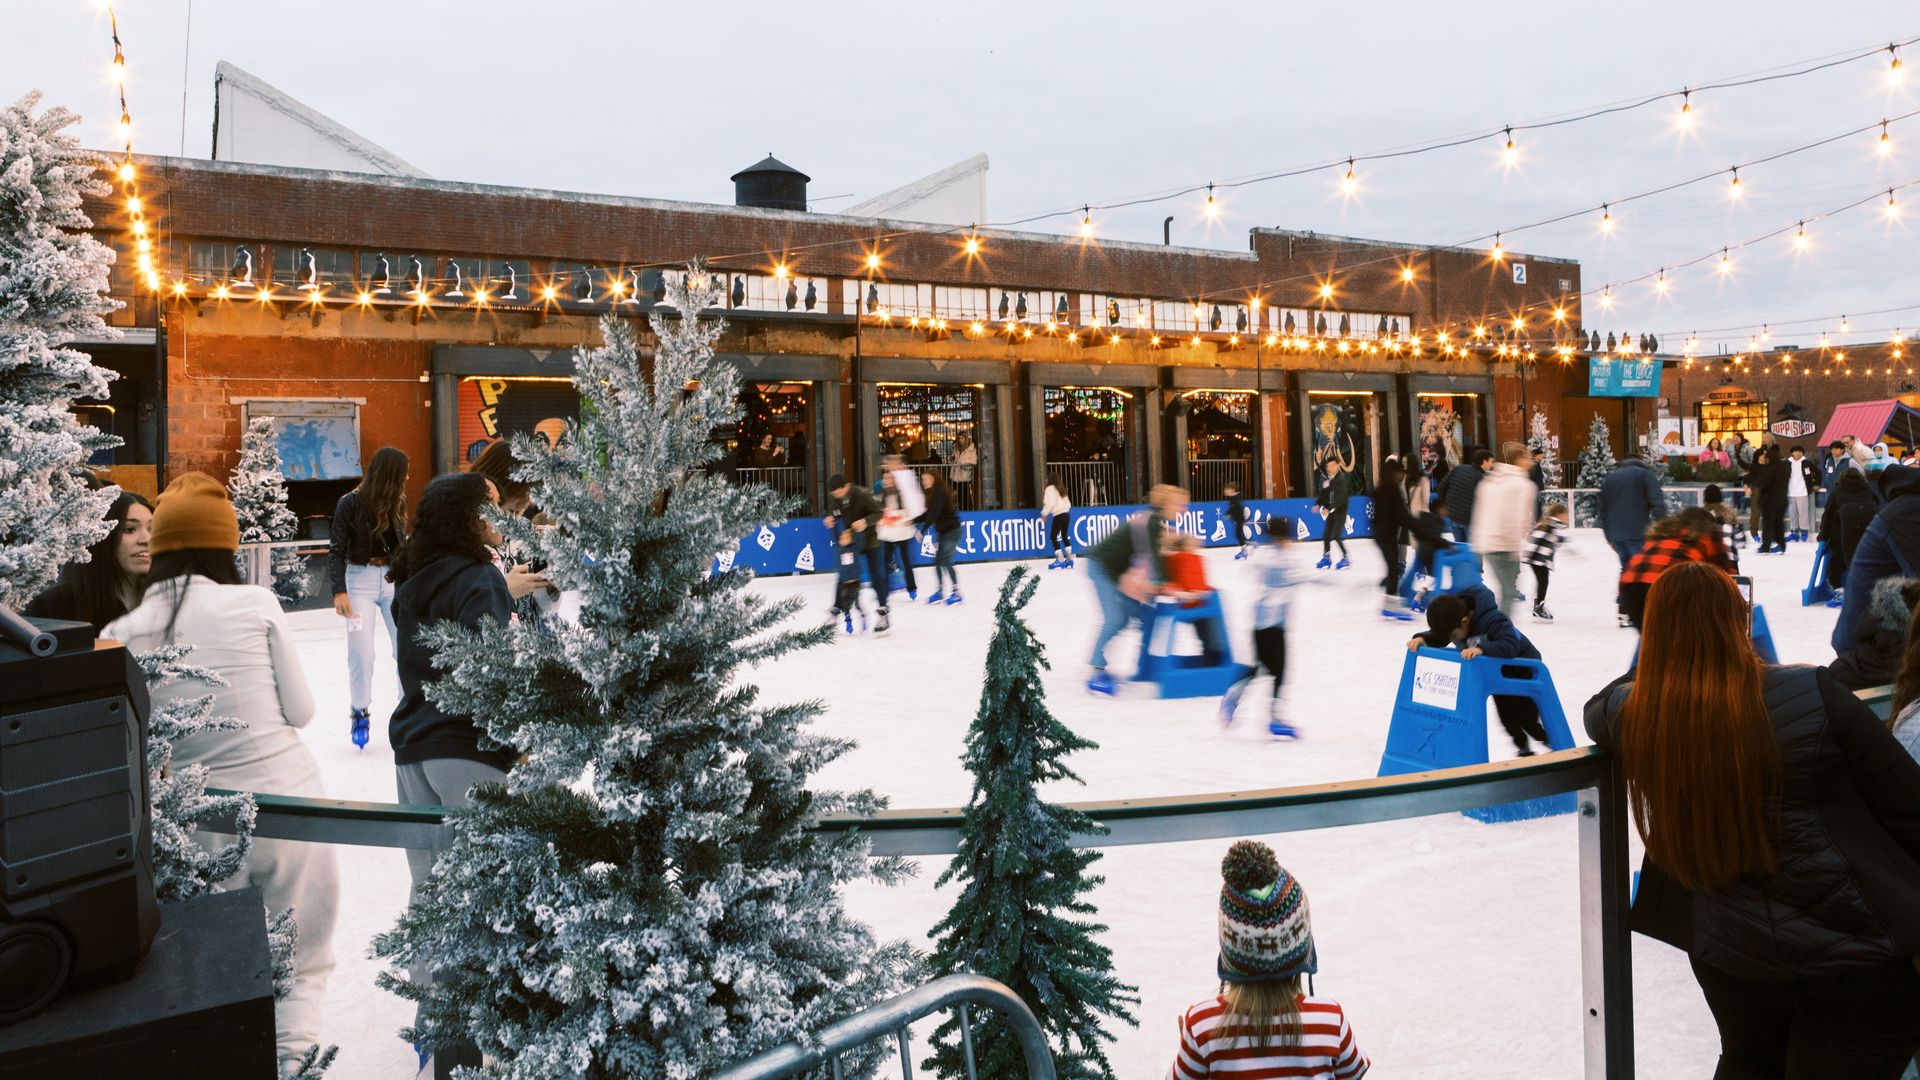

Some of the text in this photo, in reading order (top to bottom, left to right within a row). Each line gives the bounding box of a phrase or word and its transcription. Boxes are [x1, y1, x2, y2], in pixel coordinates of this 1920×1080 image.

[1515, 265, 1524, 282] 2
[981, 518, 1046, 552] SKATING
[1073, 513, 1119, 547] CAMP
